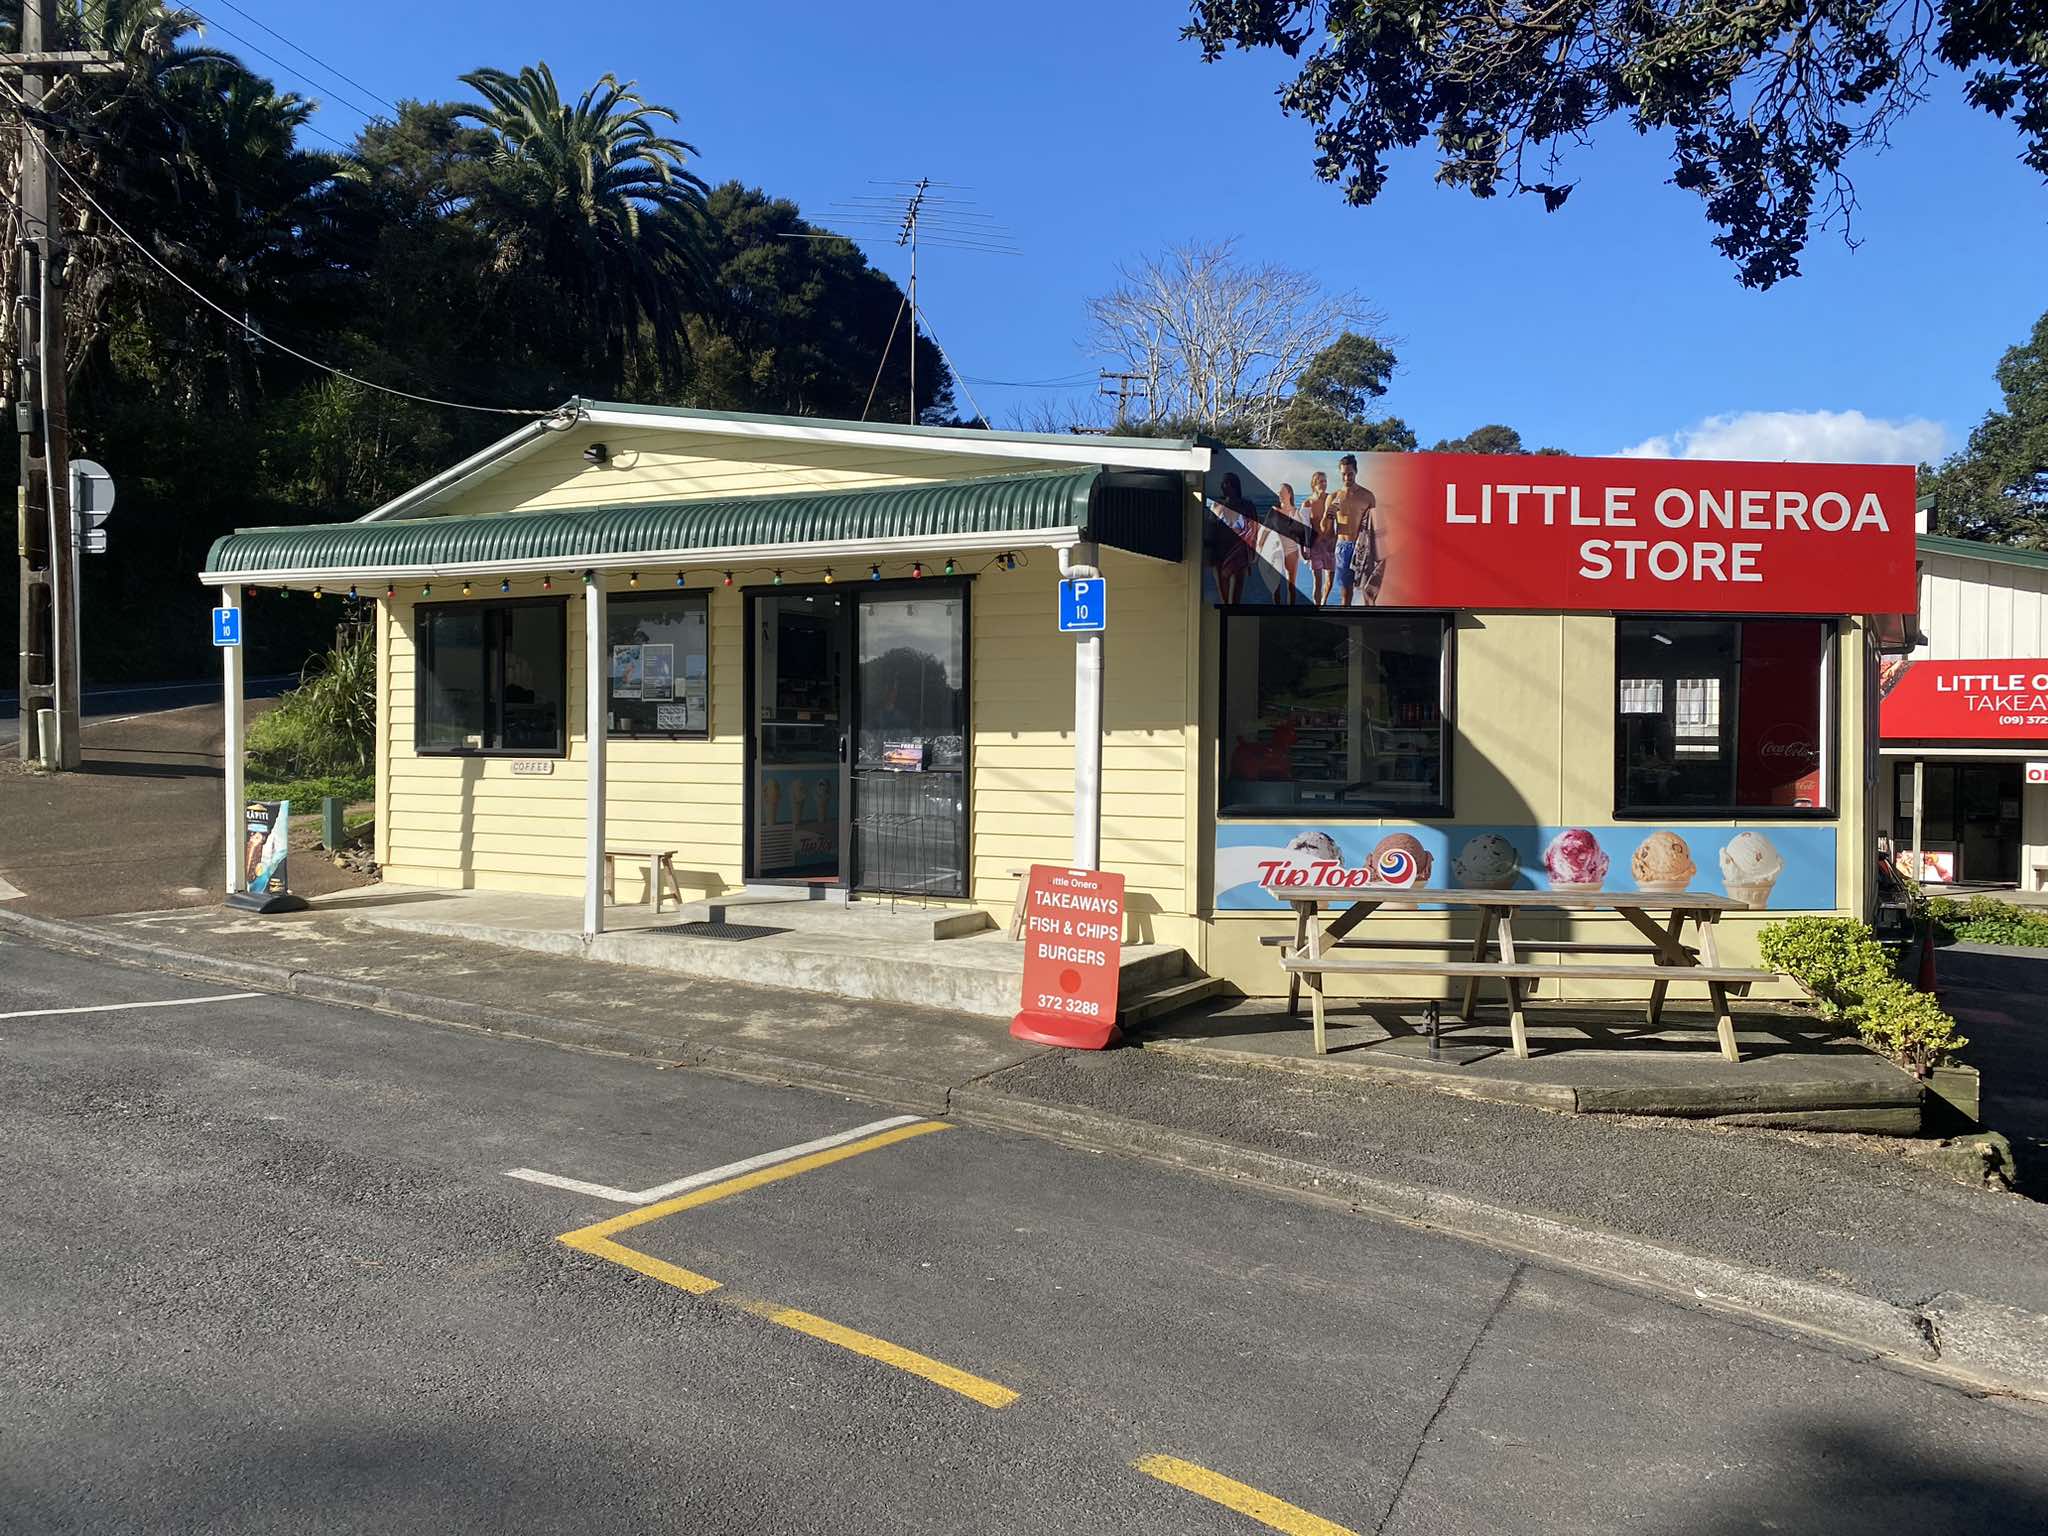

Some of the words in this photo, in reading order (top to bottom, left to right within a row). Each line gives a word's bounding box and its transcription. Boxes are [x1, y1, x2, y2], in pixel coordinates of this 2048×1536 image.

[1446, 483, 1637, 527] LITTLE
[1654, 487, 1890, 532] ONEROA
[1578, 539, 1763, 582] STORE
[1075, 582, 1089, 601] P
[222, 610, 231, 624] P
[1076, 605, 1088, 619] 10
[223, 625, 231, 637] 10
[1936, 674, 2025, 692] LITTLE
[1964, 695, 2048, 711] TAKEA
[1999, 715, 2024, 726] (09)
[513, 762, 549, 771] COFFEE
[1258, 860, 1309, 887] Tip
[1311, 861, 1370, 887] Top
[1051, 876, 1069, 887] ittle
[1071, 878, 1099, 890] Onero
[1034, 890, 1119, 915] TAKEAWAYS
[1029, 916, 1060, 934] FISH
[1063, 920, 1073, 935] &
[1076, 922, 1119, 941] CHIPS
[1038, 943, 1106, 967] BURGERS
[1037, 994, 1063, 1010] 372
[1065, 998, 1099, 1016] 3288
